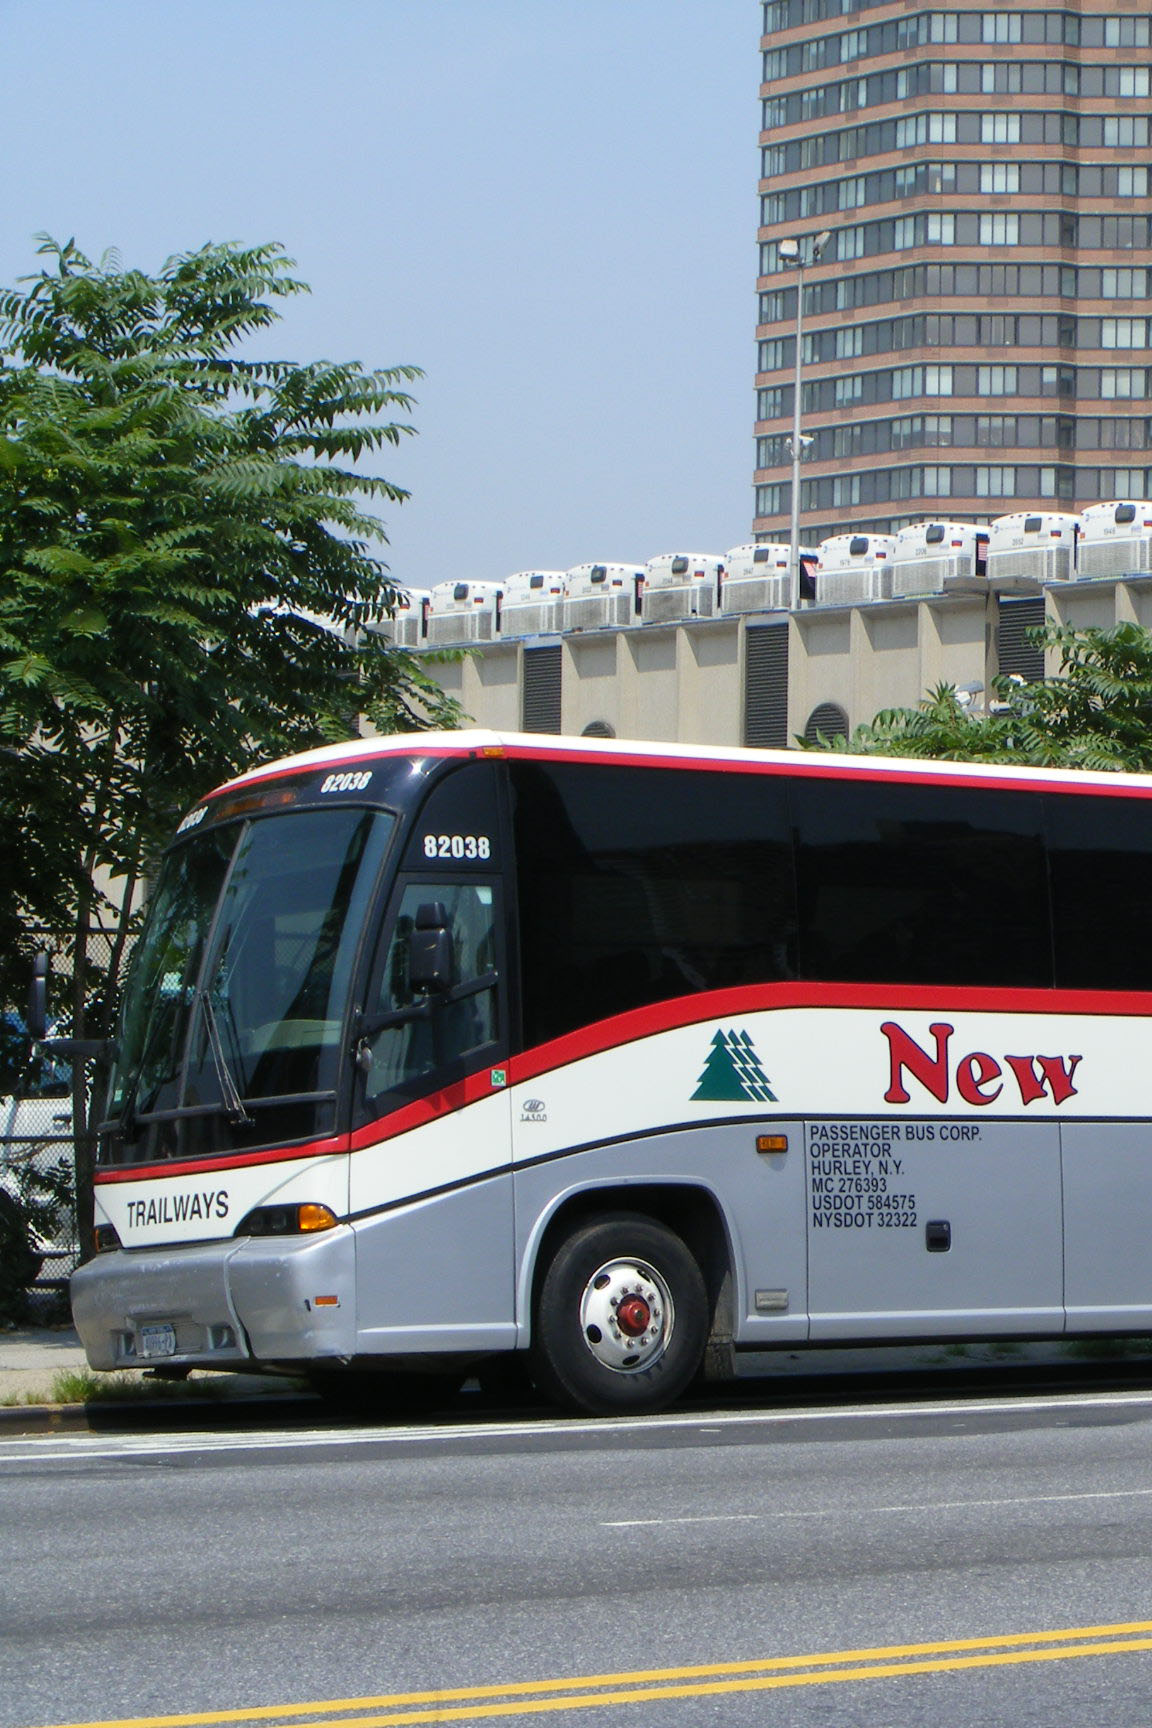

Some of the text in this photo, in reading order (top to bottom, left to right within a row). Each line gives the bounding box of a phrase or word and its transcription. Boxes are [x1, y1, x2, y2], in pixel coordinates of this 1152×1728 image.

[320, 770, 373, 794] 82038
[423, 834, 491, 859] 82038
[879, 1022, 1083, 1106] New
[810, 1125, 983, 1141] PASSENGER BUS CORP.
[810, 1142, 892, 1159] OPERATOR
[811, 1159, 905, 1177] HURLEY, N.Y.
[812, 1177, 888, 1194] MC 276393
[127, 1190, 229, 1228] TRAILWAYS
[812, 1194, 916, 1211] USDOT 584575
[812, 1211, 918, 1229] NYSDOT 32322
